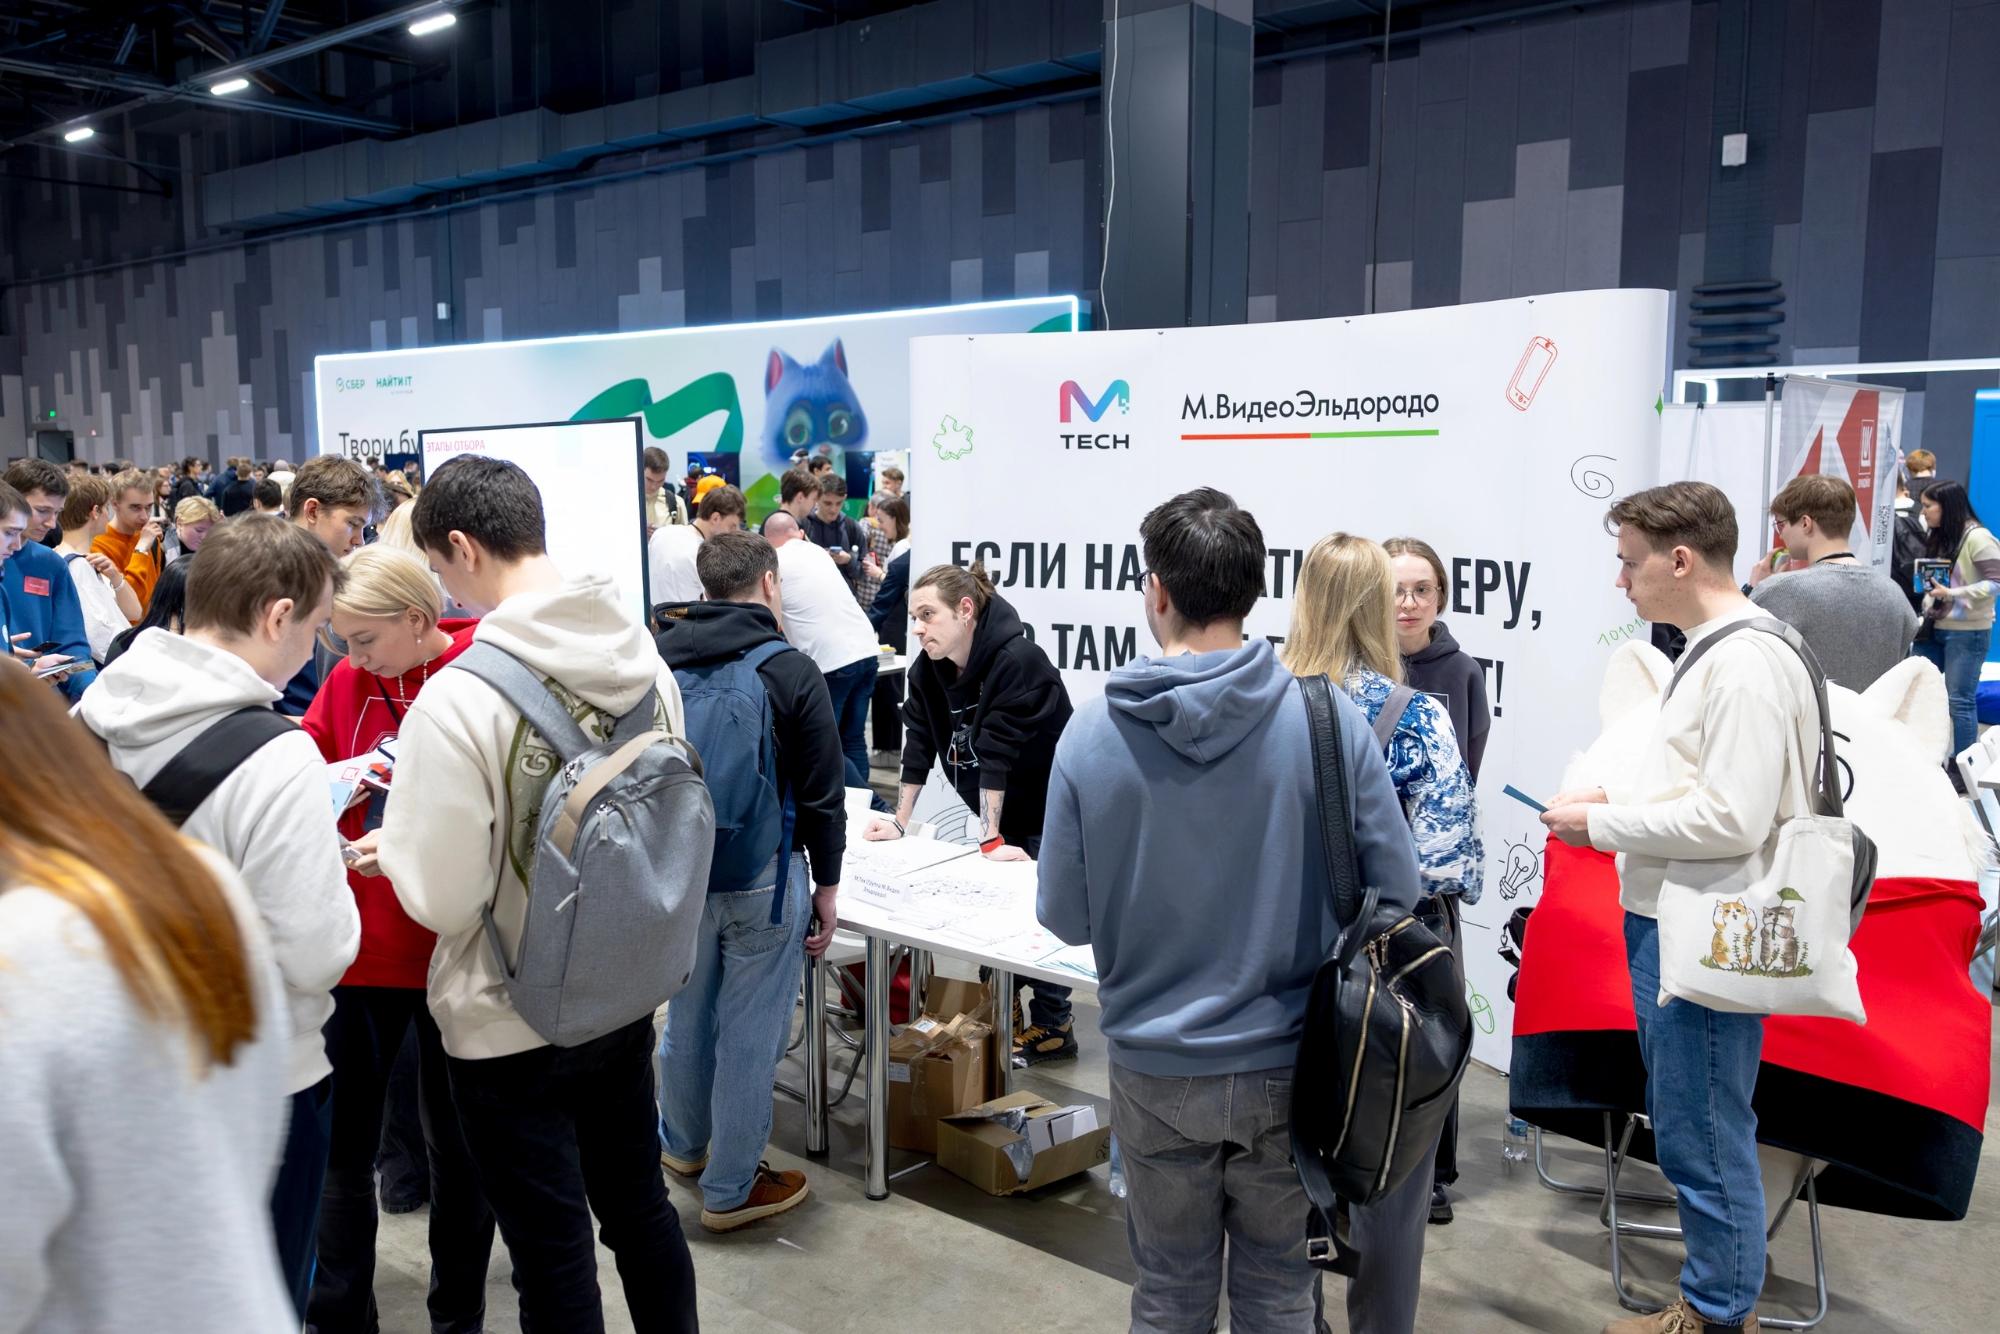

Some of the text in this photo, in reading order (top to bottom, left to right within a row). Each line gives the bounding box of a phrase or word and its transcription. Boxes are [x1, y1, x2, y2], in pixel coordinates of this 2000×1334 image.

[346, 379, 365, 389] СБЕР
[1181, 390, 1439, 422] М.ВидеоЭльдорадо
[339, 432, 392, 457] Твори
[426, 440, 485, 452] ЭТАПЫ ОТБОРА
[1060, 434, 1129, 449] TECH
